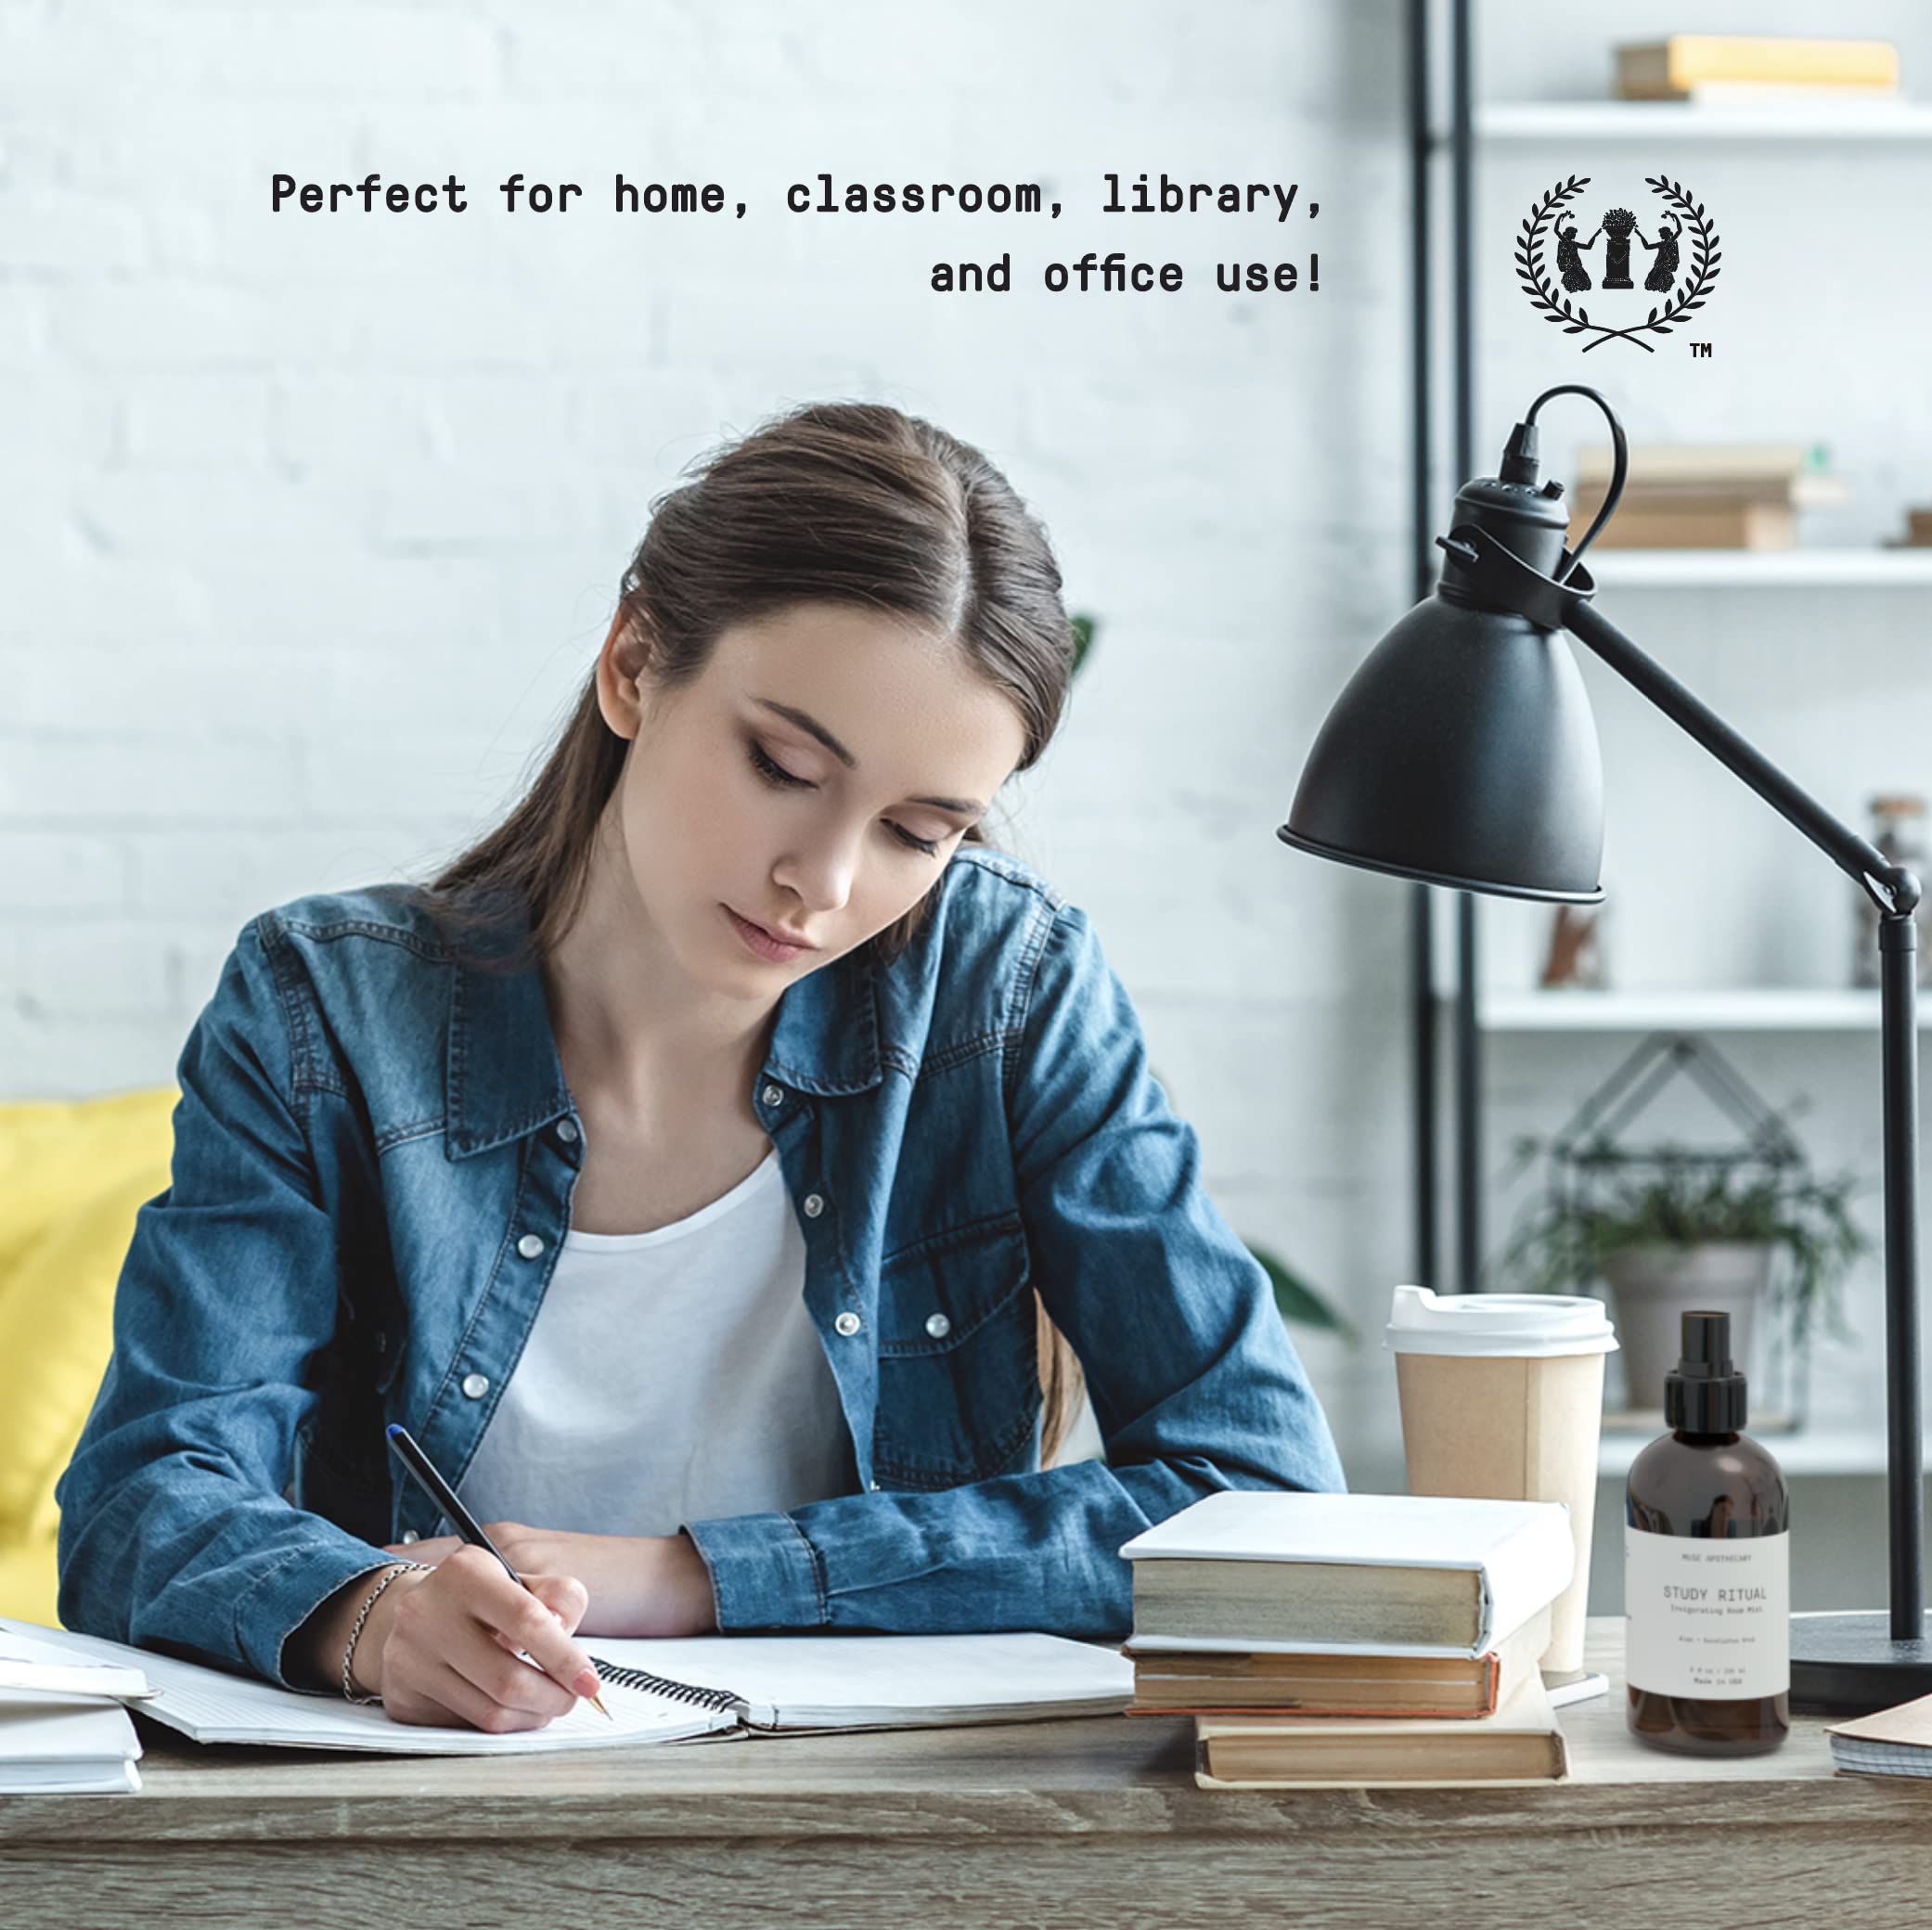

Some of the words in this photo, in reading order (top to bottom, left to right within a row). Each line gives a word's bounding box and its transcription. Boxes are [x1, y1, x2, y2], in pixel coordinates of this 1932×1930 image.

[1705, 1553, 1752, 1563] APOTHECARY
[1663, 1586, 1708, 1601] STUDY
[1718, 1587, 1767, 1602] RITUAL
[1669, 1603, 1724, 1616] Invigorating
